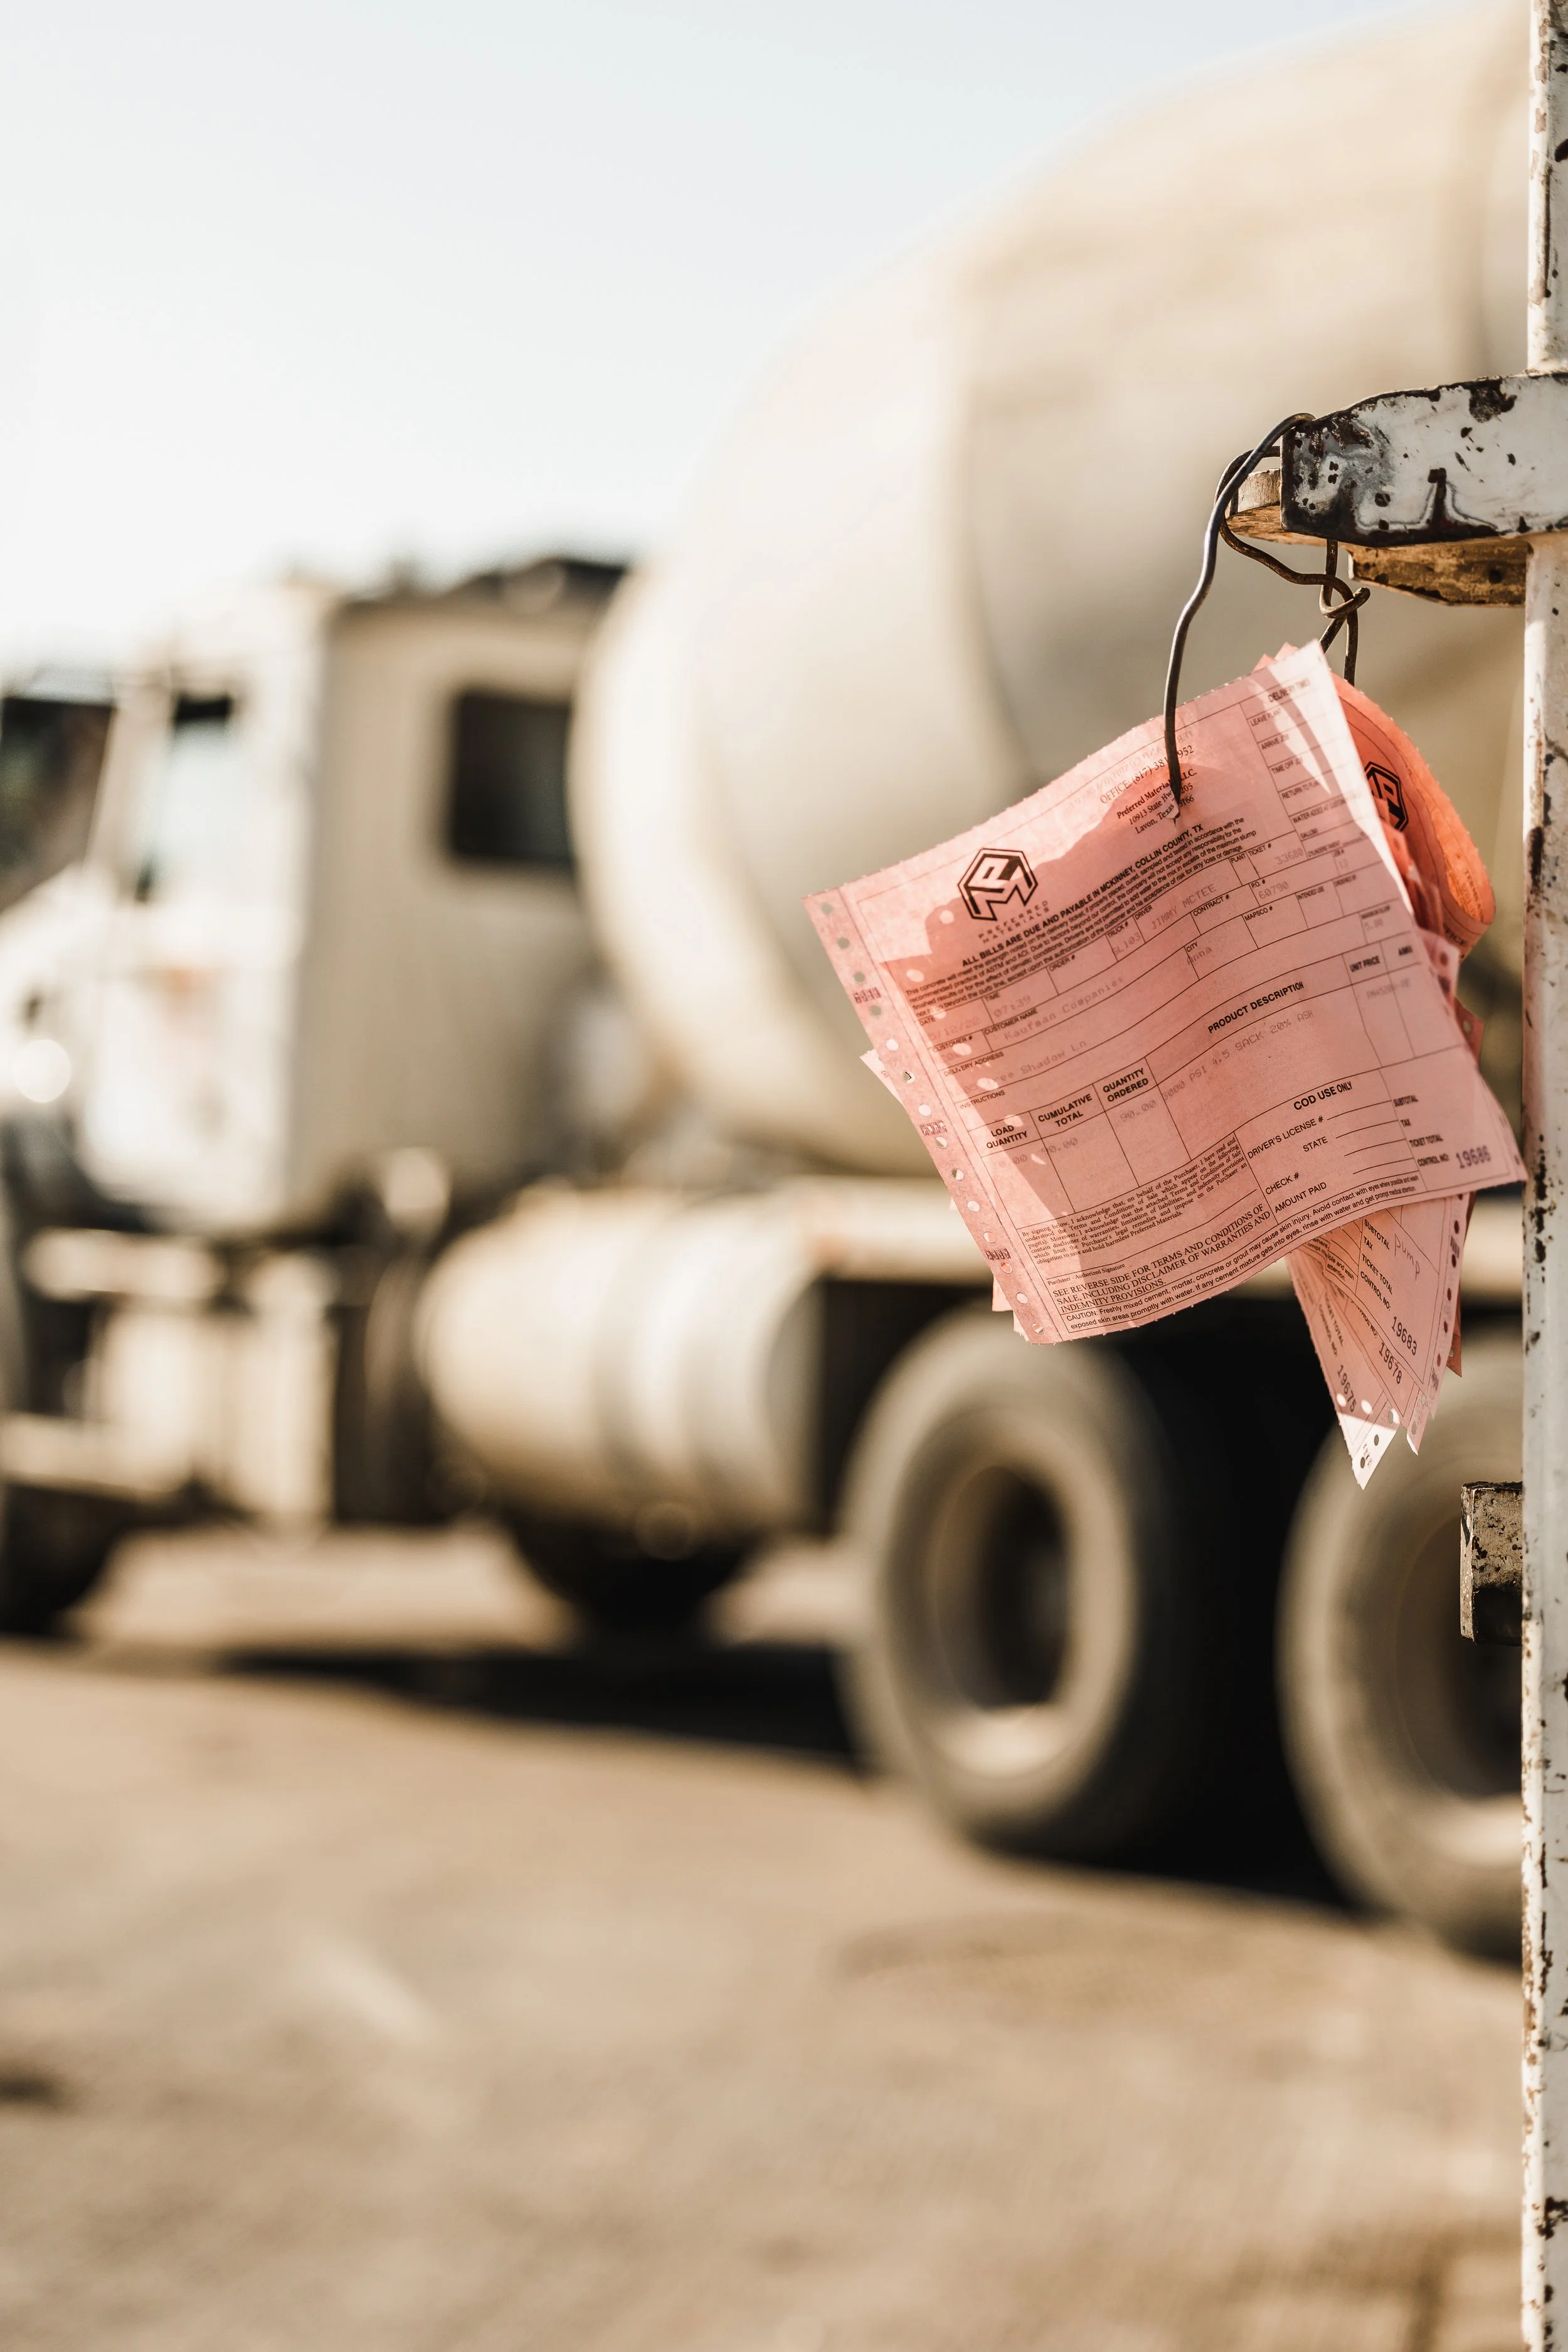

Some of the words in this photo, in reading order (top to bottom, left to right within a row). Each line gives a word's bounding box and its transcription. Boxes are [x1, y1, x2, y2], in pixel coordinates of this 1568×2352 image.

[1131, 766, 1152, 785] (817)
[1116, 797, 1145, 819] Preferred
[1130, 810, 1147, 825] 10913
[1147, 800, 1162, 813] State
[1135, 818, 1158, 834] Lavon,
[1157, 803, 1175, 819] Texas
[1230, 853, 1246, 864] PLANT
[1248, 845, 1266, 857] TICKET
[961, 955, 978, 967] ALL
[978, 942, 1005, 959] BILLS
[1004, 933, 1022, 947] ARE
[1022, 924, 1042, 938] DUE
[1041, 914, 1060, 928] AND
[1059, 893, 1093, 920] PAYABLE
[1091, 889, 1101, 899] IN
[1098, 866, 1135, 894] MCKINNEY,
[1133, 848, 1162, 869] COLLIN
[1161, 830, 1192, 852] COUNTY,
[1191, 823, 1204, 834] TX
[1193, 897, 1224, 917] CONTRACT
[1134, 905, 1153, 921] DRIVER
[1244, 907, 1268, 922] MAPSCO
[1107, 924, 1125, 939] TRUCK
[1186, 941, 1199, 953] CITY
[1350, 958, 1363, 973] UNIT
[1363, 955, 1380, 969] PRICE
[984, 992, 1000, 1002] TIME
[1207, 1006, 1249, 1034] PRODUCT
[1249, 981, 1305, 1010] DESCRIPTION
[984, 1016, 1015, 1036] CUSTOMER
[1015, 1007, 1038, 1022] NAME
[933, 1037, 967, 1052] CUSTOMER
[974, 1051, 1004, 1066] ADDRESS
[1103, 1067, 1145, 1093] QUANTITY
[1107, 1078, 1149, 1102] ORDERED
[960, 1090, 1005, 1109] INSTRUCTIONS
[1037, 1093, 1093, 1123] CUMULATIVE
[1293, 1095, 1316, 1111] COD
[1317, 1089, 1337, 1101] USE
[1337, 1081, 1353, 1093] ONLY
[991, 1125, 1015, 1137] LOAD
[1055, 1111, 1084, 1128] TOTAL
[986, 1131, 1028, 1149] QUANTITY
[1247, 1135, 1282, 1159] DRIVER'S
[1282, 1119, 1317, 1140] LICENSE
[1303, 1136, 1328, 1153] STATE
[1265, 1175, 1293, 1195] CHECK
[1274, 1190, 1308, 1214] AMOUNT
[1308, 1182, 1327, 1196] PAID
[1036, 1253, 1062, 1266] obligation
[1081, 1246, 1092, 1254] and
[1091, 1241, 1106, 1252] hold
[1104, 1232, 1130, 1247] harmless
[1130, 1221, 1158, 1237] Preferred
[1157, 1209, 1182, 1225] Materials.
[1363, 1236, 1374, 1251] TAX
[1364, 1219, 1391, 1250] SUBTOTAL
[1052, 1288, 1069, 1297] SEE
[1070, 1279, 1109, 1293] REVERSE
[1109, 1273, 1131, 1285] SIDE
[1131, 1264, 1150, 1277] FOR
[1150, 1250, 1183, 1269] TERMS
[1182, 1241, 1204, 1255] AND
[1203, 1210, 1254, 1246] CONDITIONS
[1251, 1202, 1265, 1215] OF
[1056, 1294, 1081, 1305] SALE,
[1082, 1282, 1130, 1299] INCLUDING
[1130, 1258, 1187, 1287] DISCLAIMER
[1187, 1251, 1202, 1263] OF
[1201, 1222, 1254, 1257] WARRANTIES
[1251, 1210, 1271, 1226] AND
[1066, 1309, 1098, 1322] CAUTION:
[1099, 1305, 1122, 1315] Freshly
[1123, 1299, 1142, 1310] mixed
[1143, 1288, 1170, 1303] cement,
[1171, 1277, 1195, 1291] mortar,
[1195, 1263, 1224, 1281] concrete
[1232, 1249, 1250, 1264] grout
[1248, 1241, 1262, 1254] may
[1261, 1231, 1279, 1244] cause
[1278, 1221, 1292, 1233] skin
[1291, 1210, 1312, 1226] injury.
[1311, 1202, 1330, 1215] Avoid
[1331, 1192, 1355, 1206] contact
[1355, 1187, 1367, 1196] with
[1368, 1184, 1380, 1193] eyes
[1047, 1276, 1071, 1286] Purchaser
[1074, 1268, 1101, 1279] Authorized
[1101, 1262, 1125, 1274] Signature
[1071, 1320, 1096, 1331] exposed
[1098, 1316, 1111, 1325] skin
[1111, 1311, 1130, 1322] areas
[1130, 1301, 1160, 1318] promptly
[1159, 1295, 1173, 1305] with
[1174, 1287, 1195, 1300] water.
[1201, 1278, 1214, 1290] any
[1214, 1266, 1239, 1283] cement
[1237, 1252, 1261, 1269] mixture
[1259, 1244, 1274, 1257] gets
[1273, 1236, 1285, 1248] into
[1285, 1227, 1302, 1241] eyes,
[1301, 1218, 1319, 1231] rinse
[1318, 1211, 1333, 1222] with
[1333, 1204, 1352, 1216] water
[1352, 1199, 1364, 1208] and
[1364, 1195, 1375, 1204] get
[1362, 1253, 1380, 1276] TICKET
[1379, 1274, 1393, 1295] TOTAL
[1061, 1296, 1110, 1312] INDEMNITY
[1110, 1277, 1165, 1301] PROVISIONS.
[1360, 1271, 1382, 1301] CONTROL
[1382, 1296, 1391, 1311] NO:
[1391, 1316, 1417, 1356] 19683
[1379, 1342, 1402, 1384] 19678
